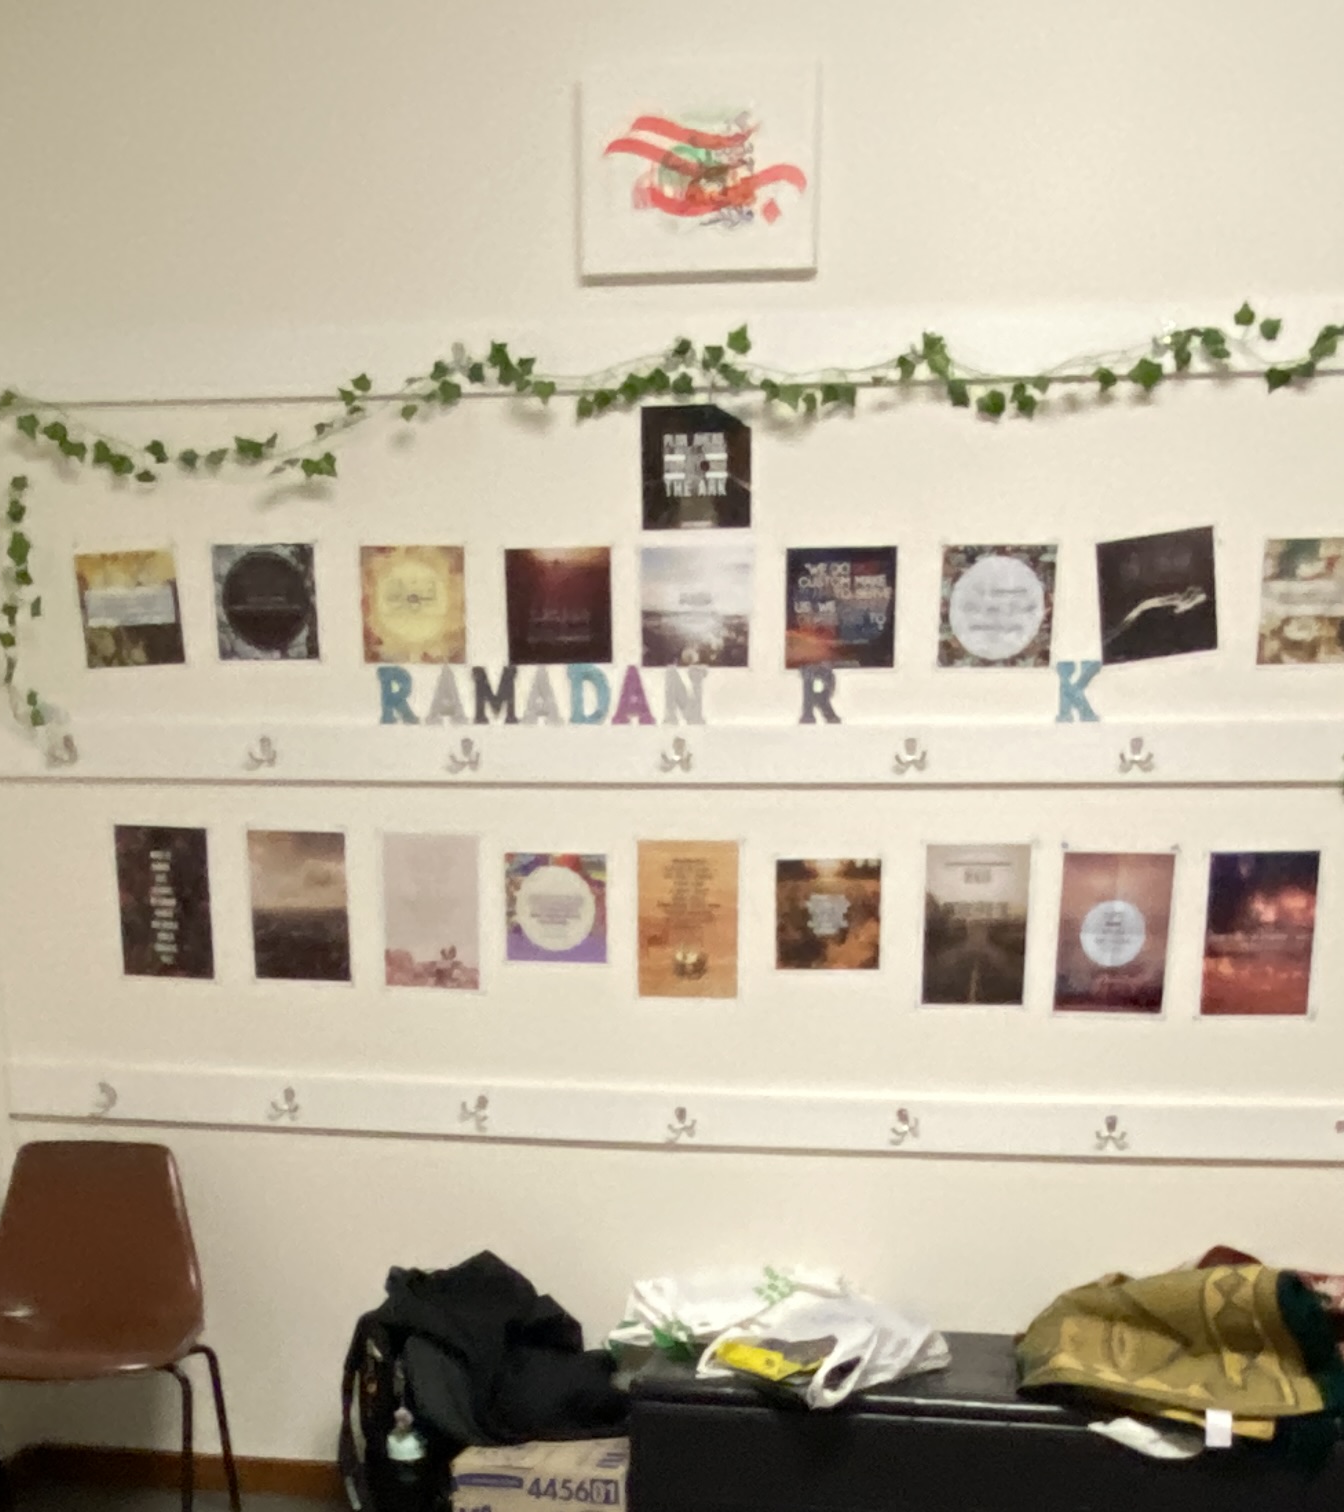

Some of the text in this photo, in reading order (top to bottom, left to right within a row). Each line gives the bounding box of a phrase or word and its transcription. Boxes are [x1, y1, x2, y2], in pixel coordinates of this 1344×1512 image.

[376, 660, 1103, 726] RAMADAN R K
